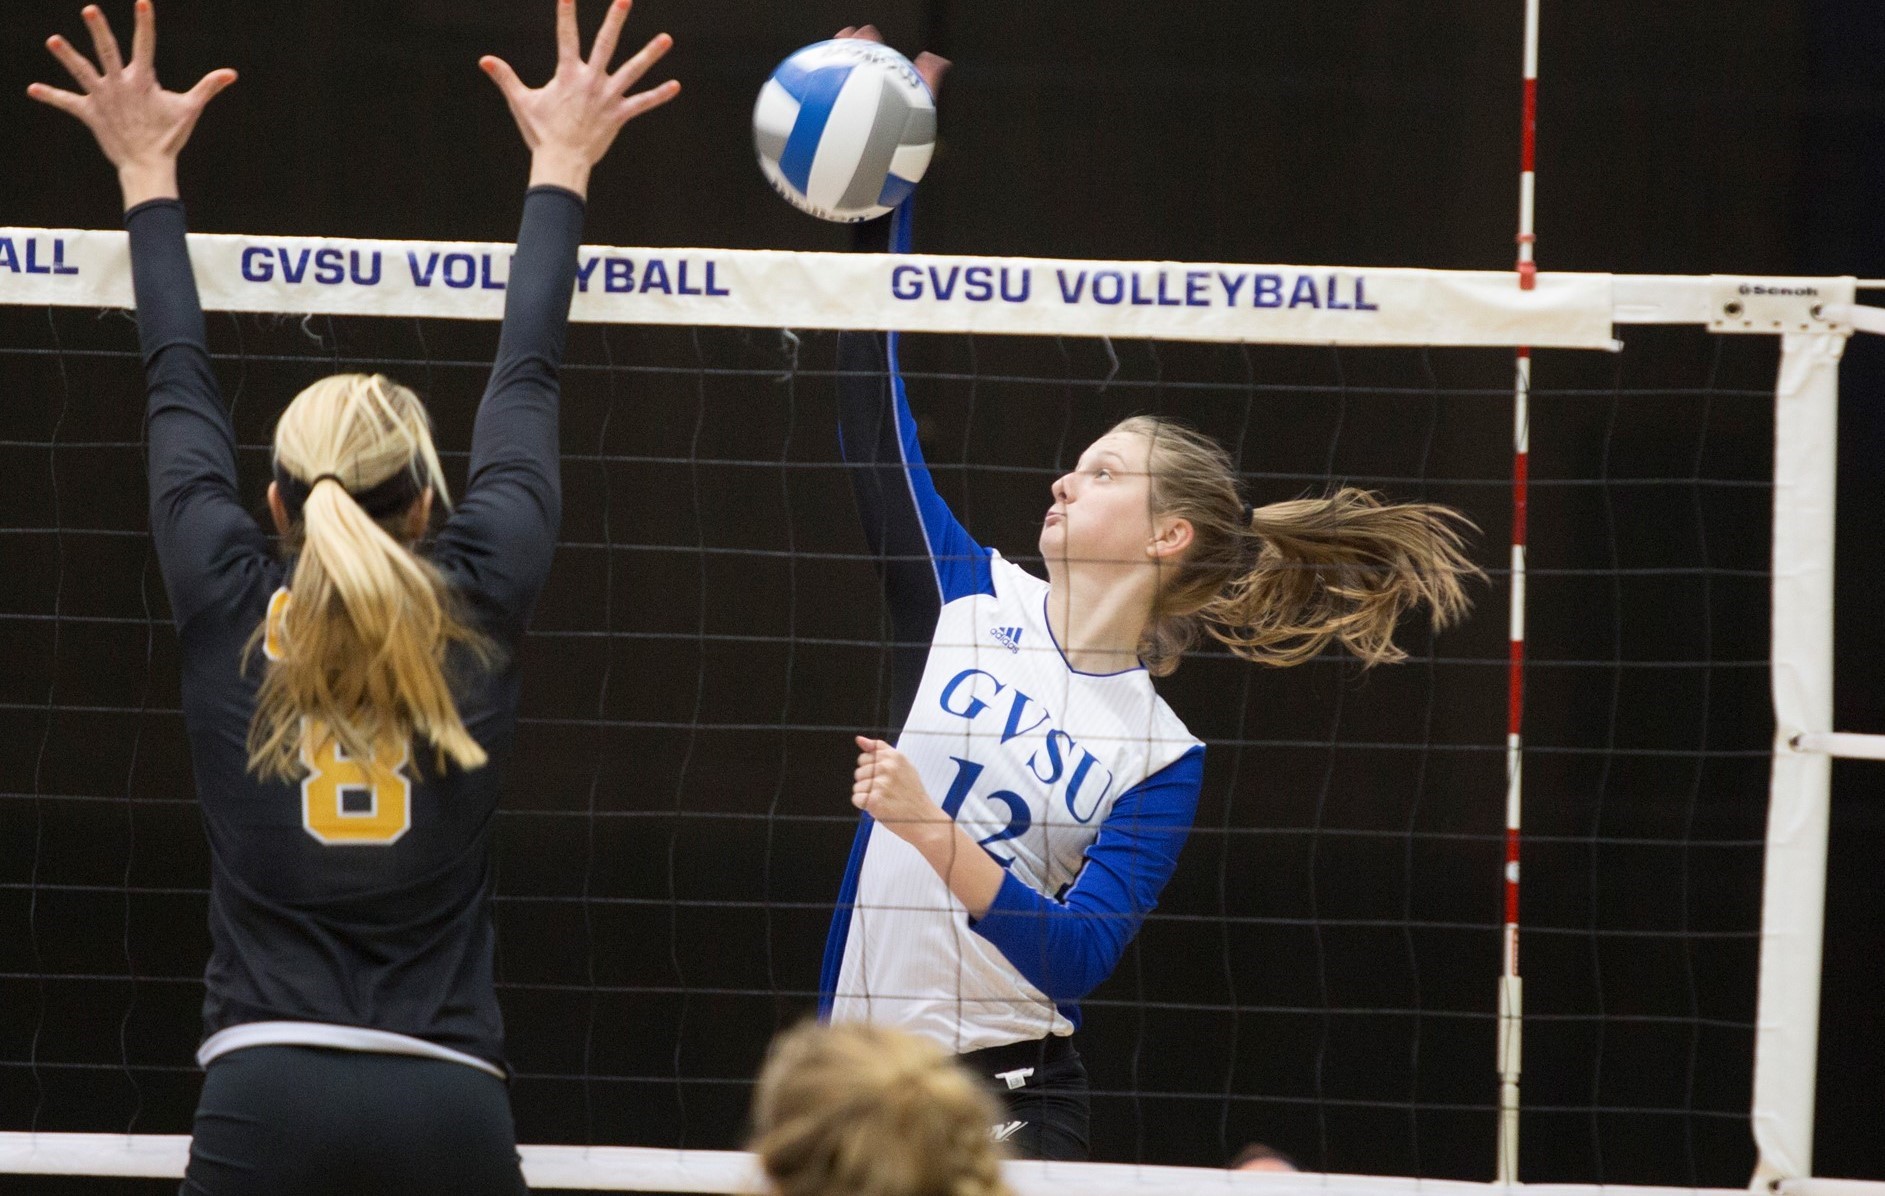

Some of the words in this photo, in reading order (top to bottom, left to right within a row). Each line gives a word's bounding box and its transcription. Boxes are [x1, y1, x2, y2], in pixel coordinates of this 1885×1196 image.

[241, 246, 382, 285] GVSU
[407, 250, 730, 296] VOLYBALL
[891, 265, 1031, 303] GVSU
[1056, 268, 1379, 312] VOLLEYBALL
[989, 627, 1020, 655] adidas
[300, 710, 412, 845] 8
[939, 668, 1114, 824] GVSU
[941, 755, 1032, 869] 12
